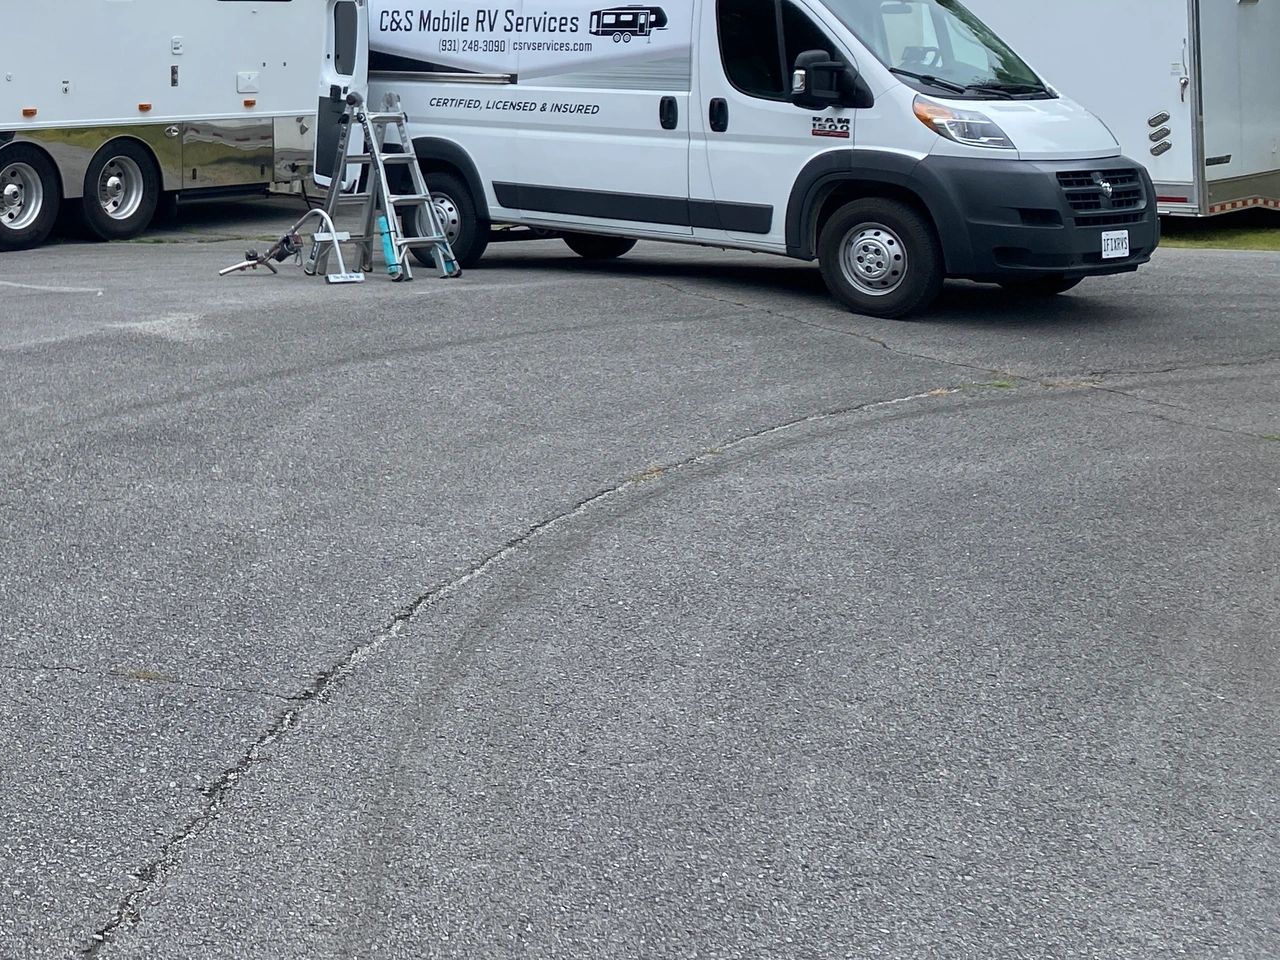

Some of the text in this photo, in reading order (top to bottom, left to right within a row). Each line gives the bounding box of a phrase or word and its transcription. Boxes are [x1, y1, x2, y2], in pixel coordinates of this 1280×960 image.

[379, 9, 580, 33] C&S Mobile RV Services
[438, 39, 506, 54] (931) 248-3090
[512, 39, 593, 52] csrvservices.com
[429, 97, 600, 115] CERTIFIED, LICENSED & INSURED
[812, 116, 850, 124] RAM
[812, 123, 850, 131] 1500
